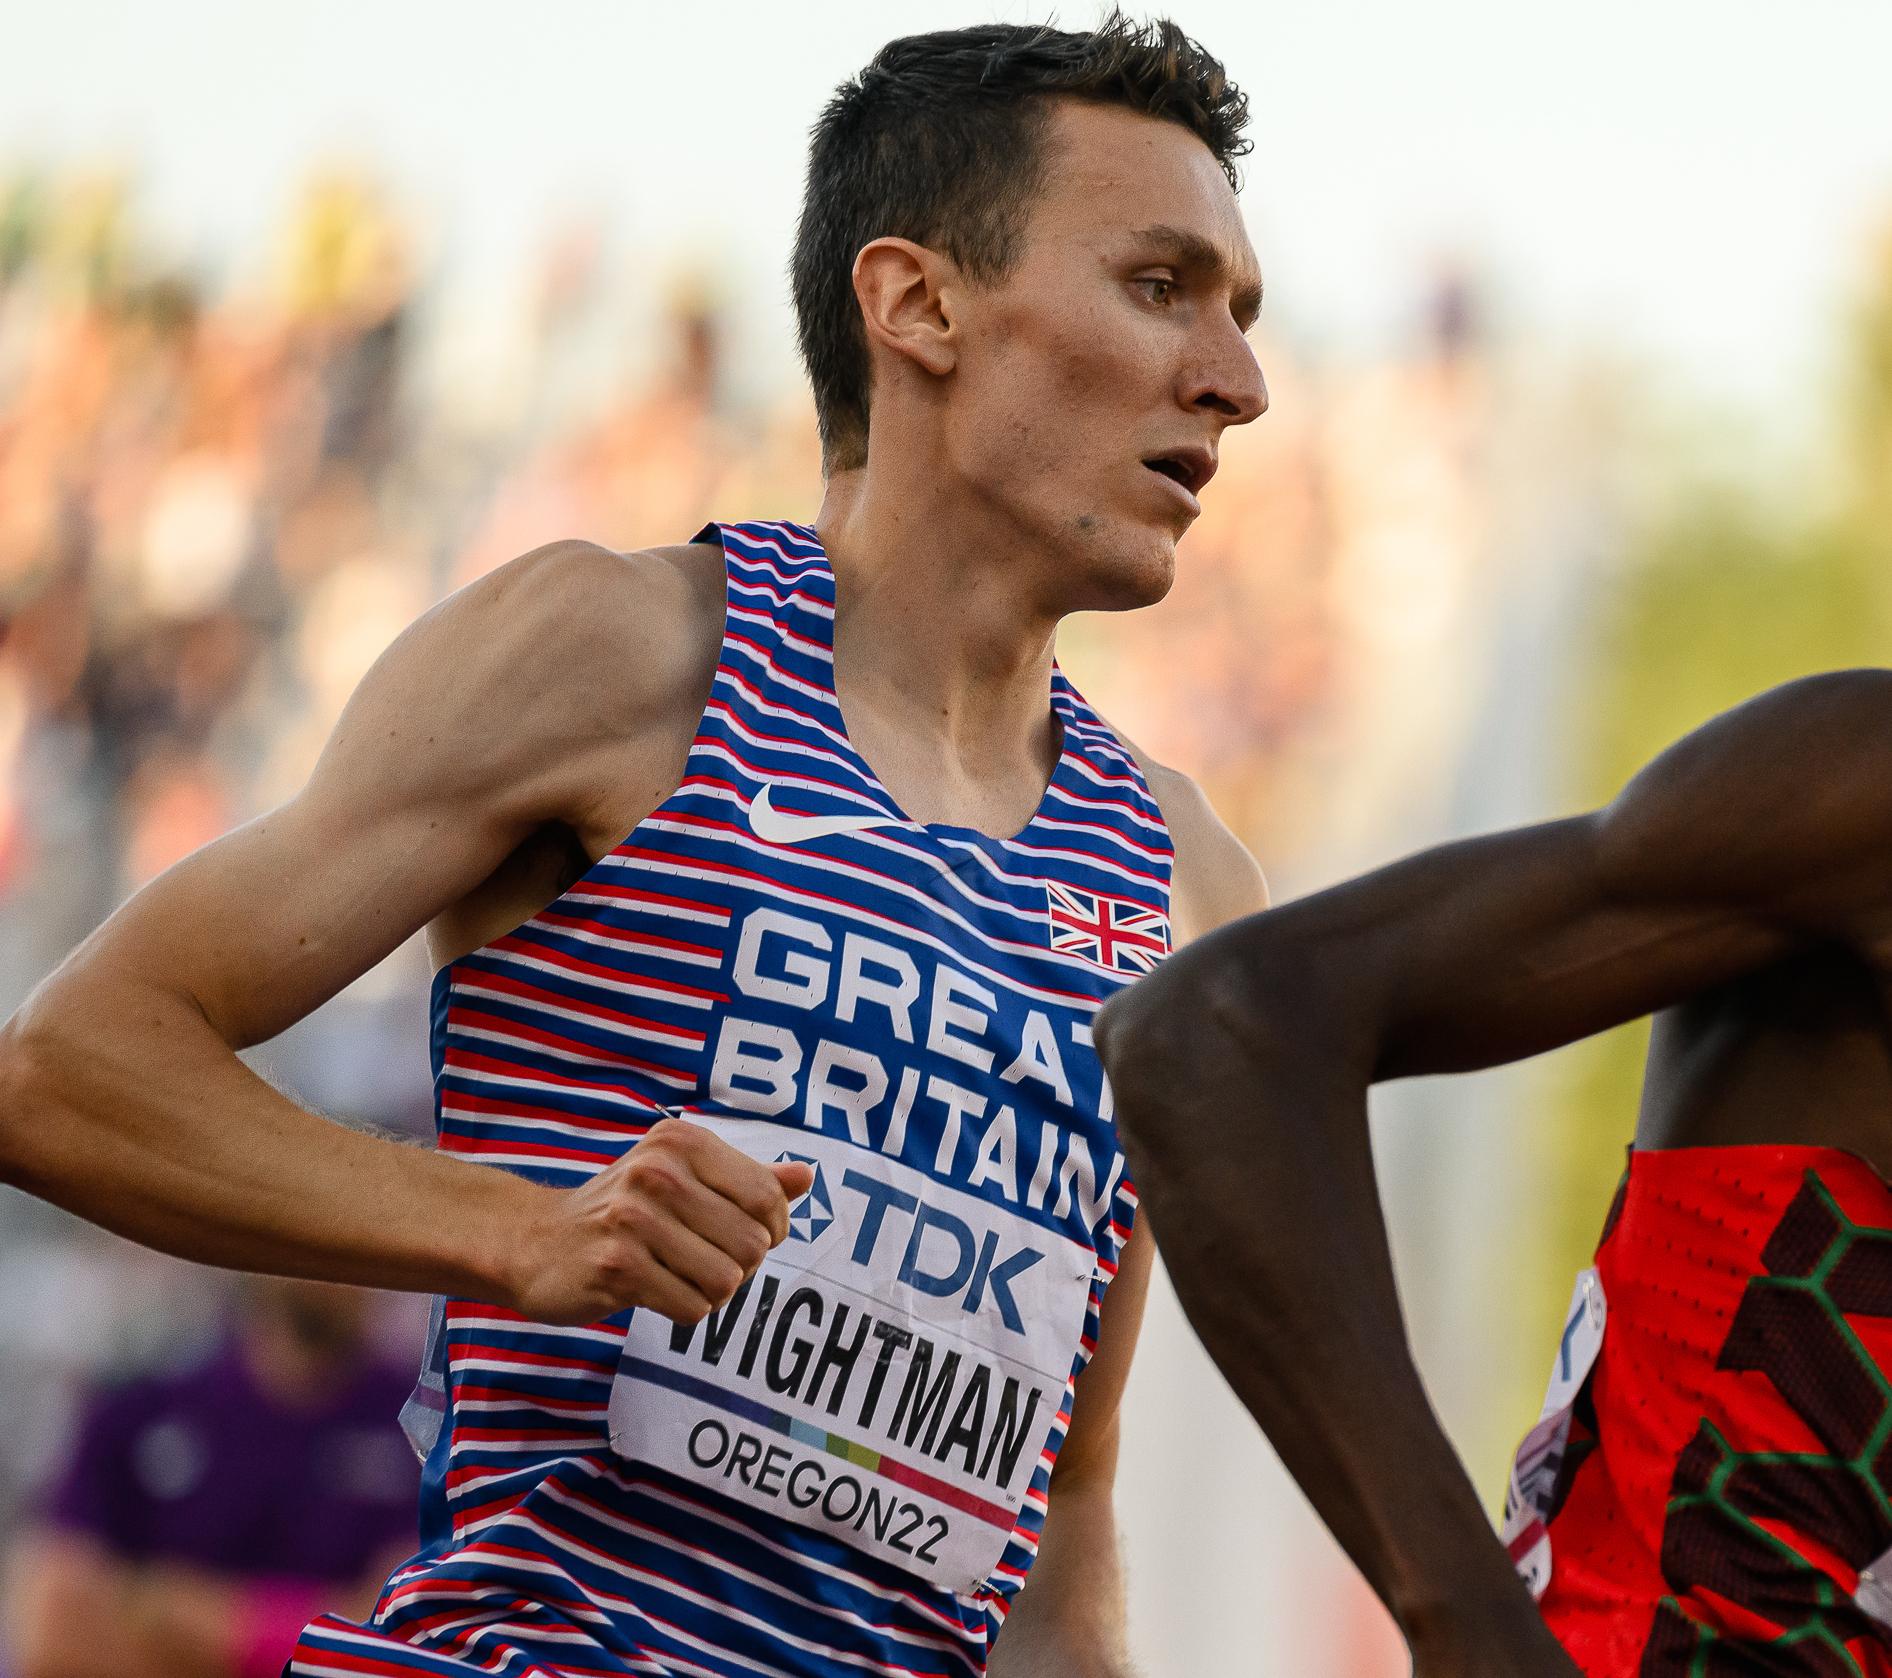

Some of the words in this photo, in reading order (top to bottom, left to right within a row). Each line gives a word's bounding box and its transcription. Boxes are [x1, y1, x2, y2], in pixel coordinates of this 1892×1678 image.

[710, 1016, 1125, 1235] BRITAIN
[842, 1168, 1046, 1336] TDK
[688, 1419, 949, 1565] OREGON22
